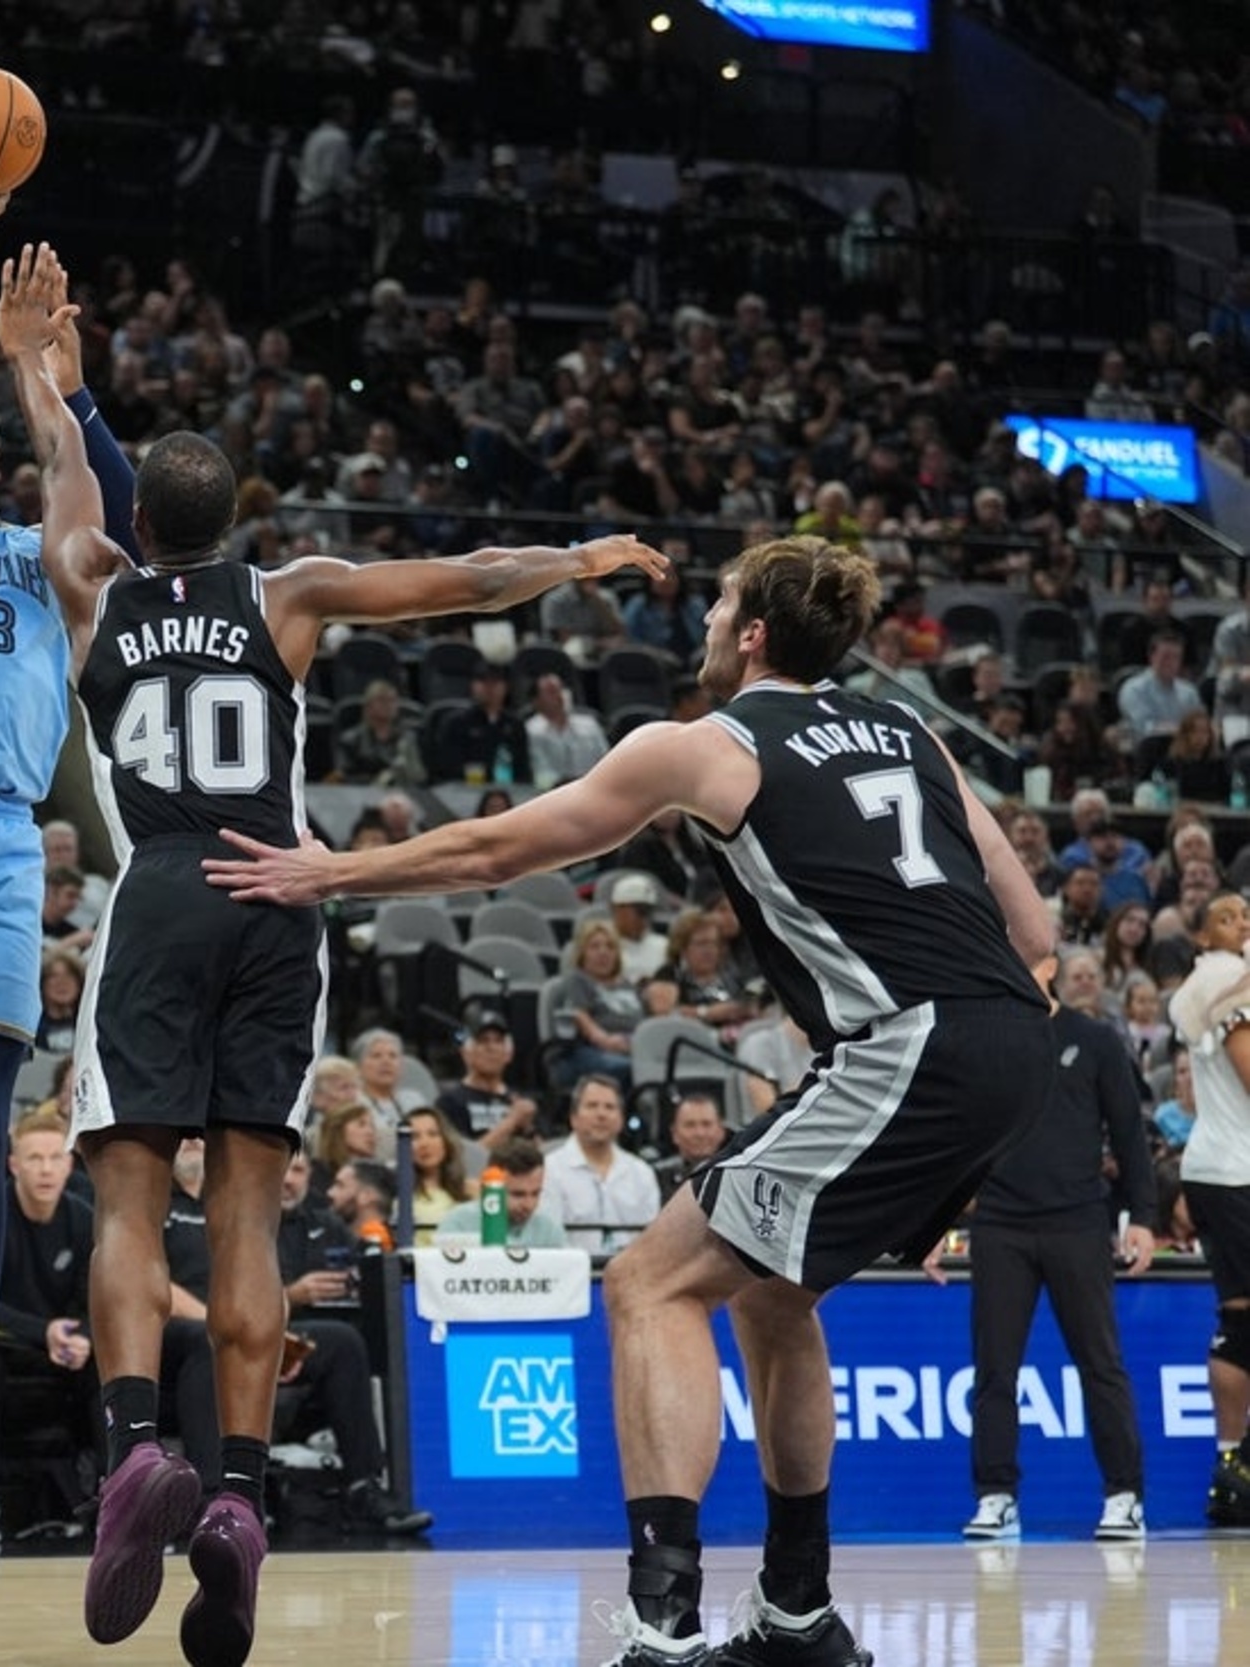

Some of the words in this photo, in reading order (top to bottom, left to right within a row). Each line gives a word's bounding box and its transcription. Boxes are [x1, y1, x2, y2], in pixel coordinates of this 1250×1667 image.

[116, 615, 249, 667] BARNES
[110, 674, 270, 794] 40
[785, 720, 912, 767] KORNET
[843, 765, 948, 890] 7
[483, 1194, 500, 1216] G
[444, 1279, 553, 1294] GATORADE
[479, 1357, 575, 1409] AM
[493, 1408, 578, 1455] EX
